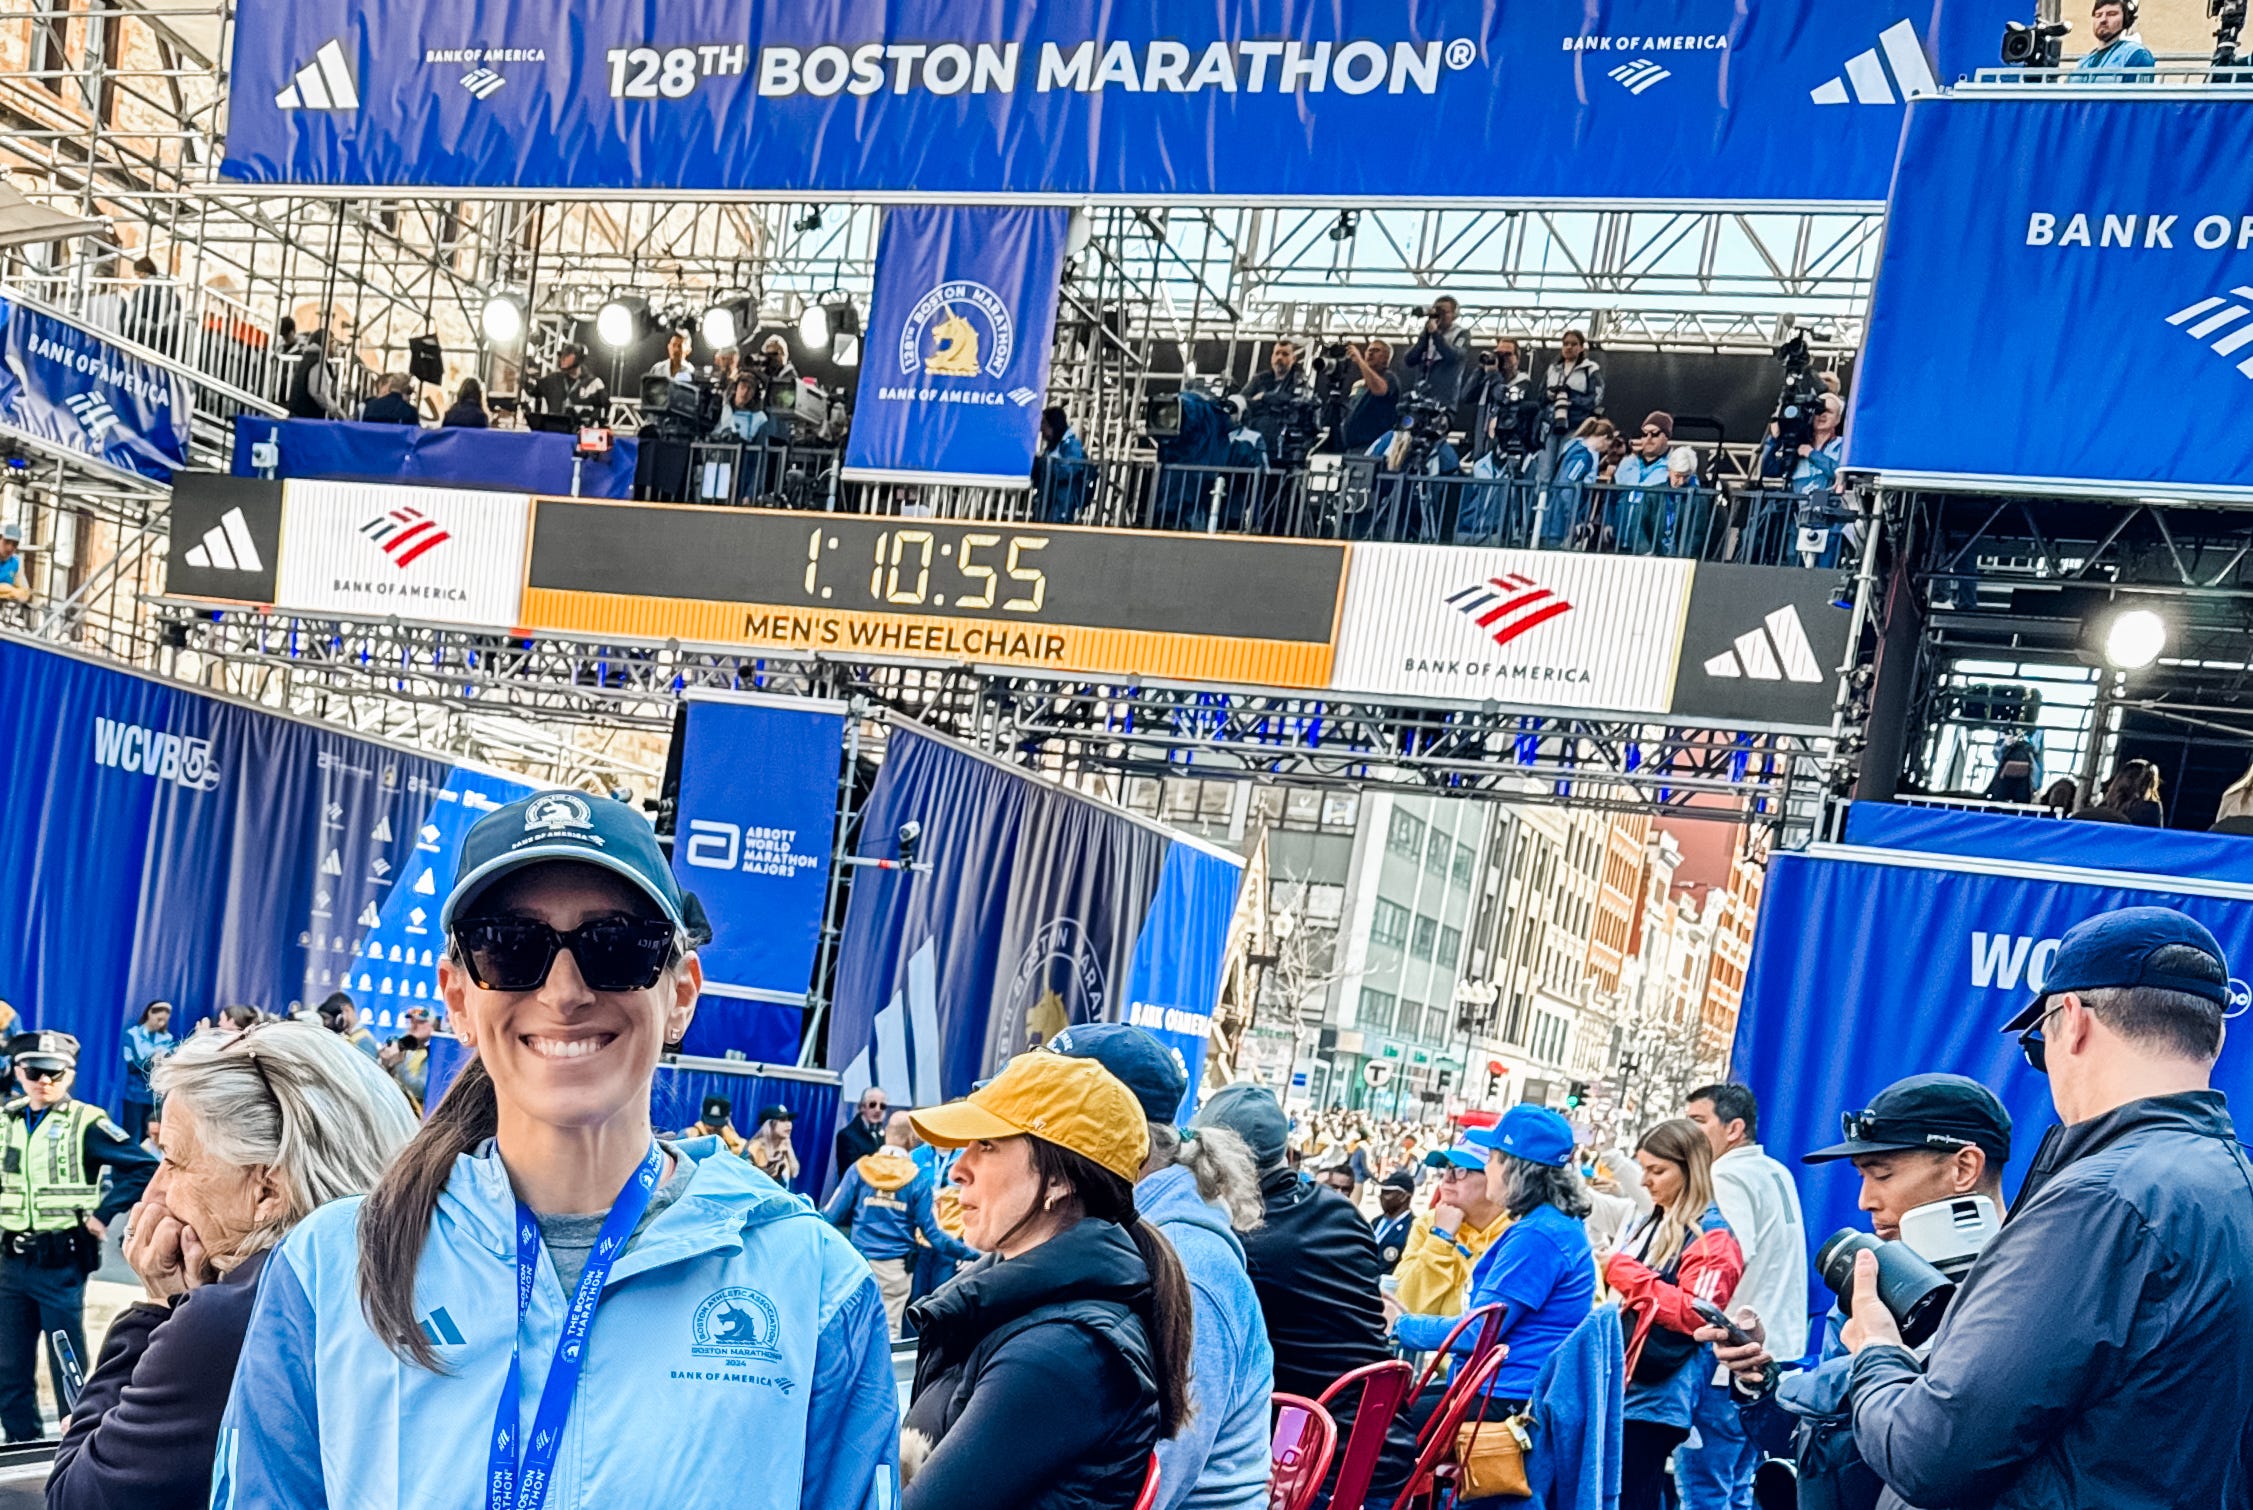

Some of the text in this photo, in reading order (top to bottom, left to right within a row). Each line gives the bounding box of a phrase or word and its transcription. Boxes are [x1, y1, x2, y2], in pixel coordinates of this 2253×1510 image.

[1562, 34, 1728, 51] BANK OF AMERICA
[426, 48, 546, 63] BANK OF AMERICA
[606, 37, 1477, 98] 128TH BOSTON MARATHON®
[2026, 212, 2179, 249] BANK
[913, 285, 967, 325] BOSTON
[972, 288, 1009, 372] MARATHON
[27, 332, 170, 407] BANK OF AMERICA
[878, 387, 1005, 405] BANK OF AMERICA
[333, 579, 467, 602] BANK OF AMERICA
[744, 612, 1066, 661] MEN'S WHEELCHAIR
[1404, 657, 1592, 684] BANK OF AMERICA
[94, 716, 182, 781] WCVB
[745, 826, 796, 842] ABBOTT
[745, 837, 791, 853] WORLD
[742, 861, 796, 878] MAJORS
[743, 849, 819, 869] MARATHON
[1369, 1065, 1387, 1081] T
[567, 1270, 596, 1336] THE BOSTON
[707, 1289, 747, 1307] ATHLETIC
[748, 1292, 777, 1344] ASSOCIATION
[691, 1346, 728, 1355] BOSTON
[725, 1359, 747, 1367] 2024
[670, 1370, 772, 1387] BANK OF AMERICA
[491, 1470, 503, 1510] OSTON
[518, 1469, 536, 1510] OSTON
